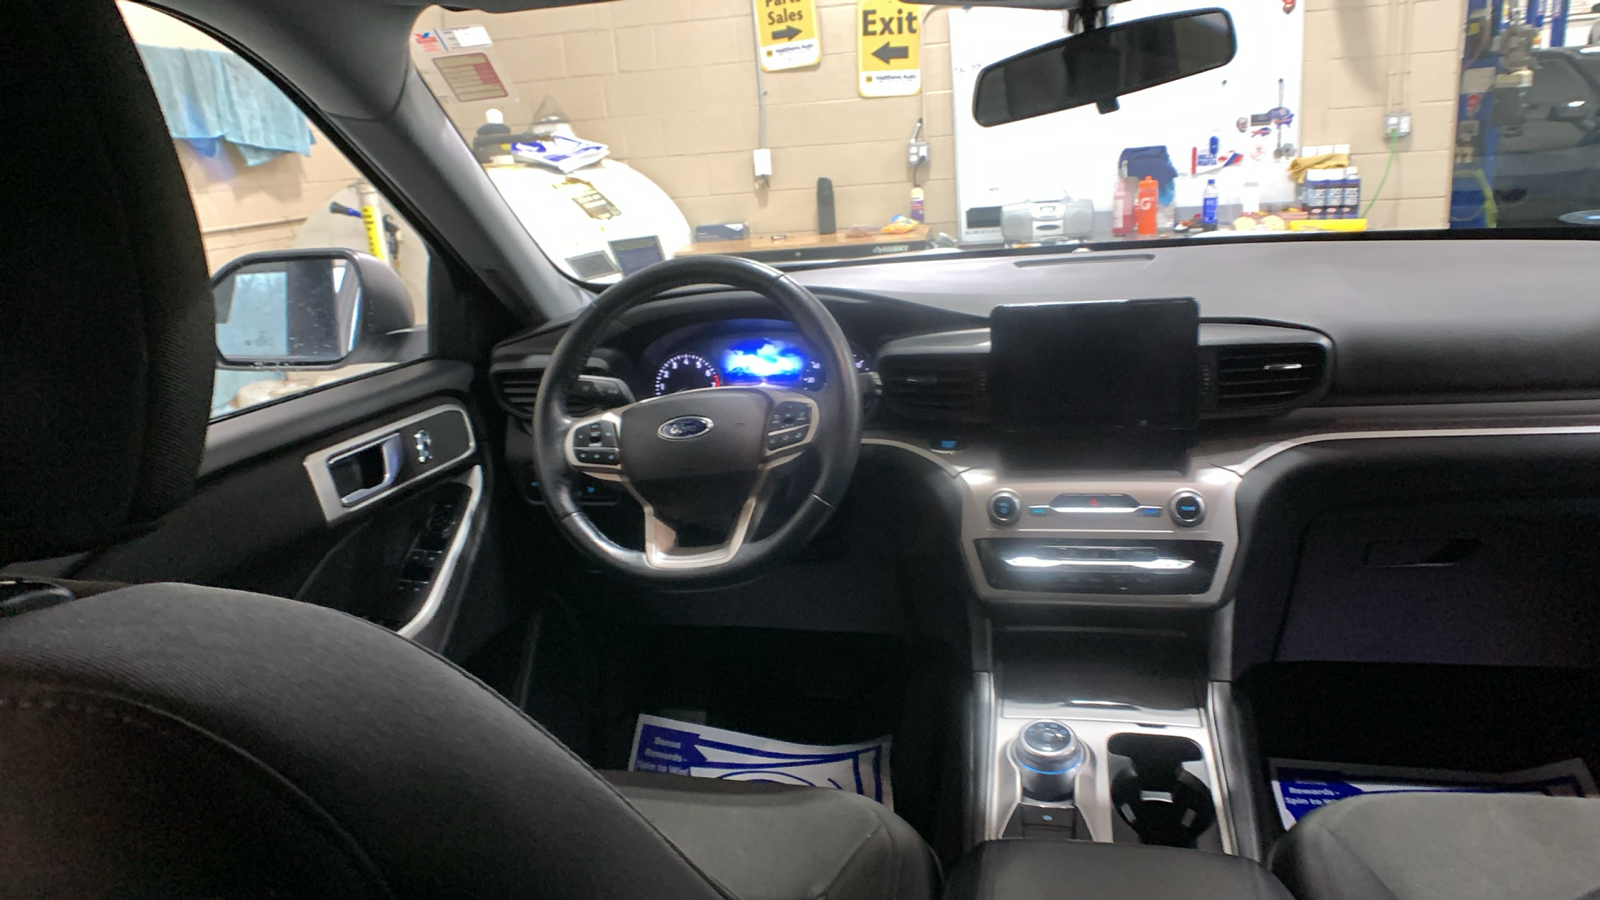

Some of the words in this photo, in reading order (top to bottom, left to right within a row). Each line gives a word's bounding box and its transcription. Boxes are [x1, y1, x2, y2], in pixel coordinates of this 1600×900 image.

[767, 7, 803, 26] Sales
[862, 8, 918, 36] Exit
[1141, 197, 1152, 211] G
[882, 245, 910, 253] HUSKY
[672, 361, 678, 369] 3
[695, 361, 702, 369] 5
[663, 370, 669, 378] 2
